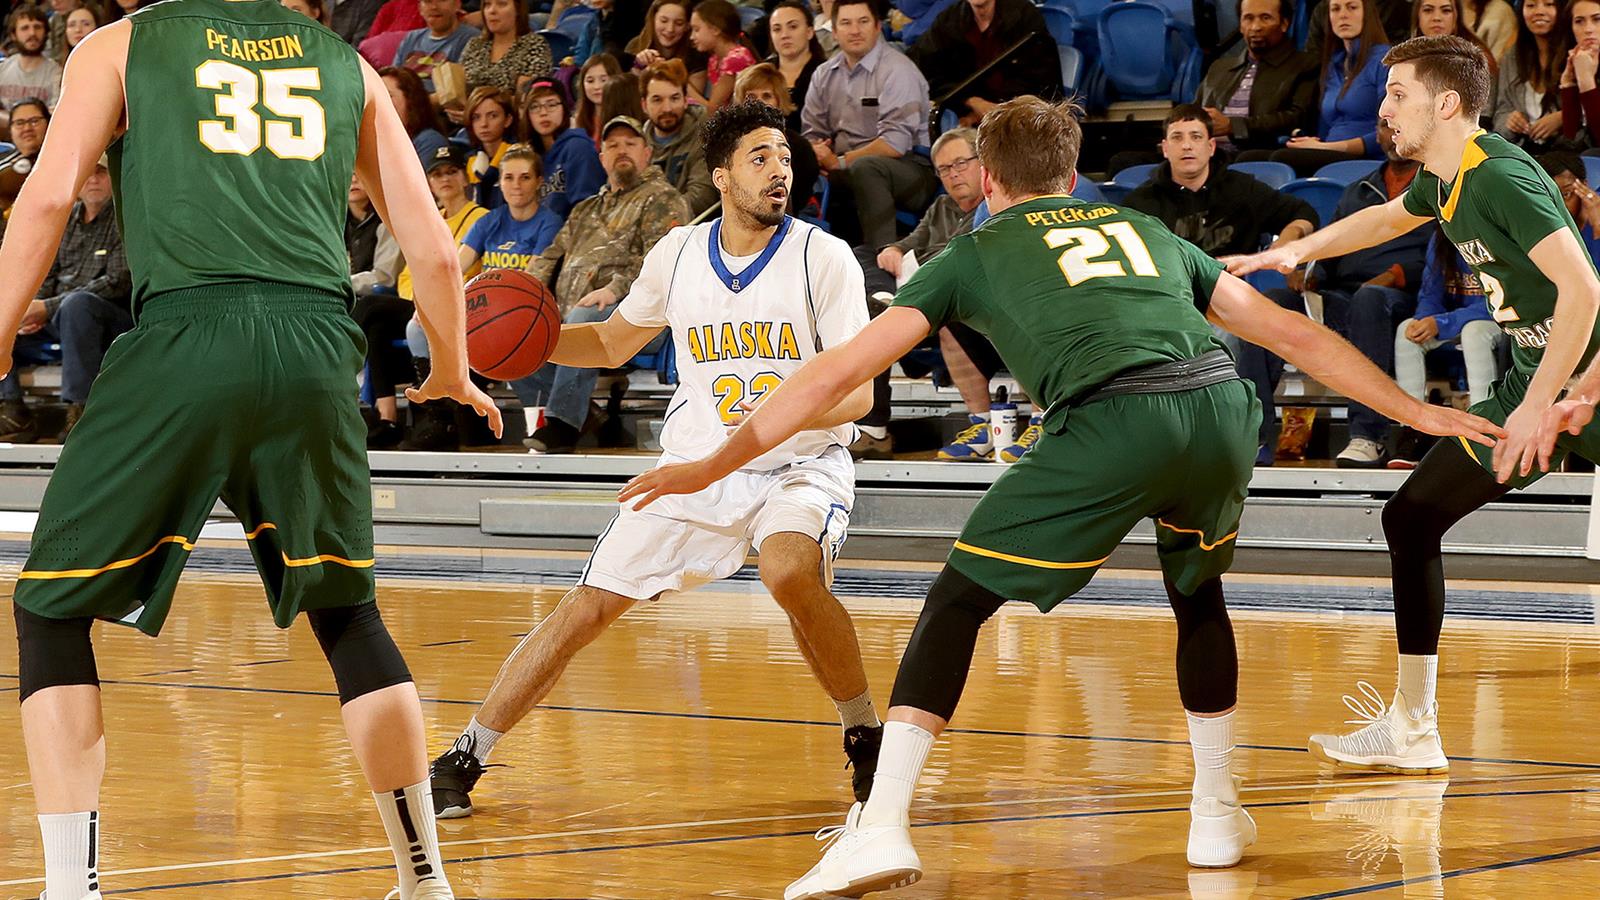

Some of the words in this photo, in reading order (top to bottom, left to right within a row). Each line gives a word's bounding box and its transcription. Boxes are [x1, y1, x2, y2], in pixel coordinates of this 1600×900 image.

[206, 28, 304, 61] PEARSON
[195, 59, 327, 161] 35
[482, 251, 531, 269] ANOOK
[1042, 221, 1161, 287] 21
[688, 321, 802, 363] ALASKA
